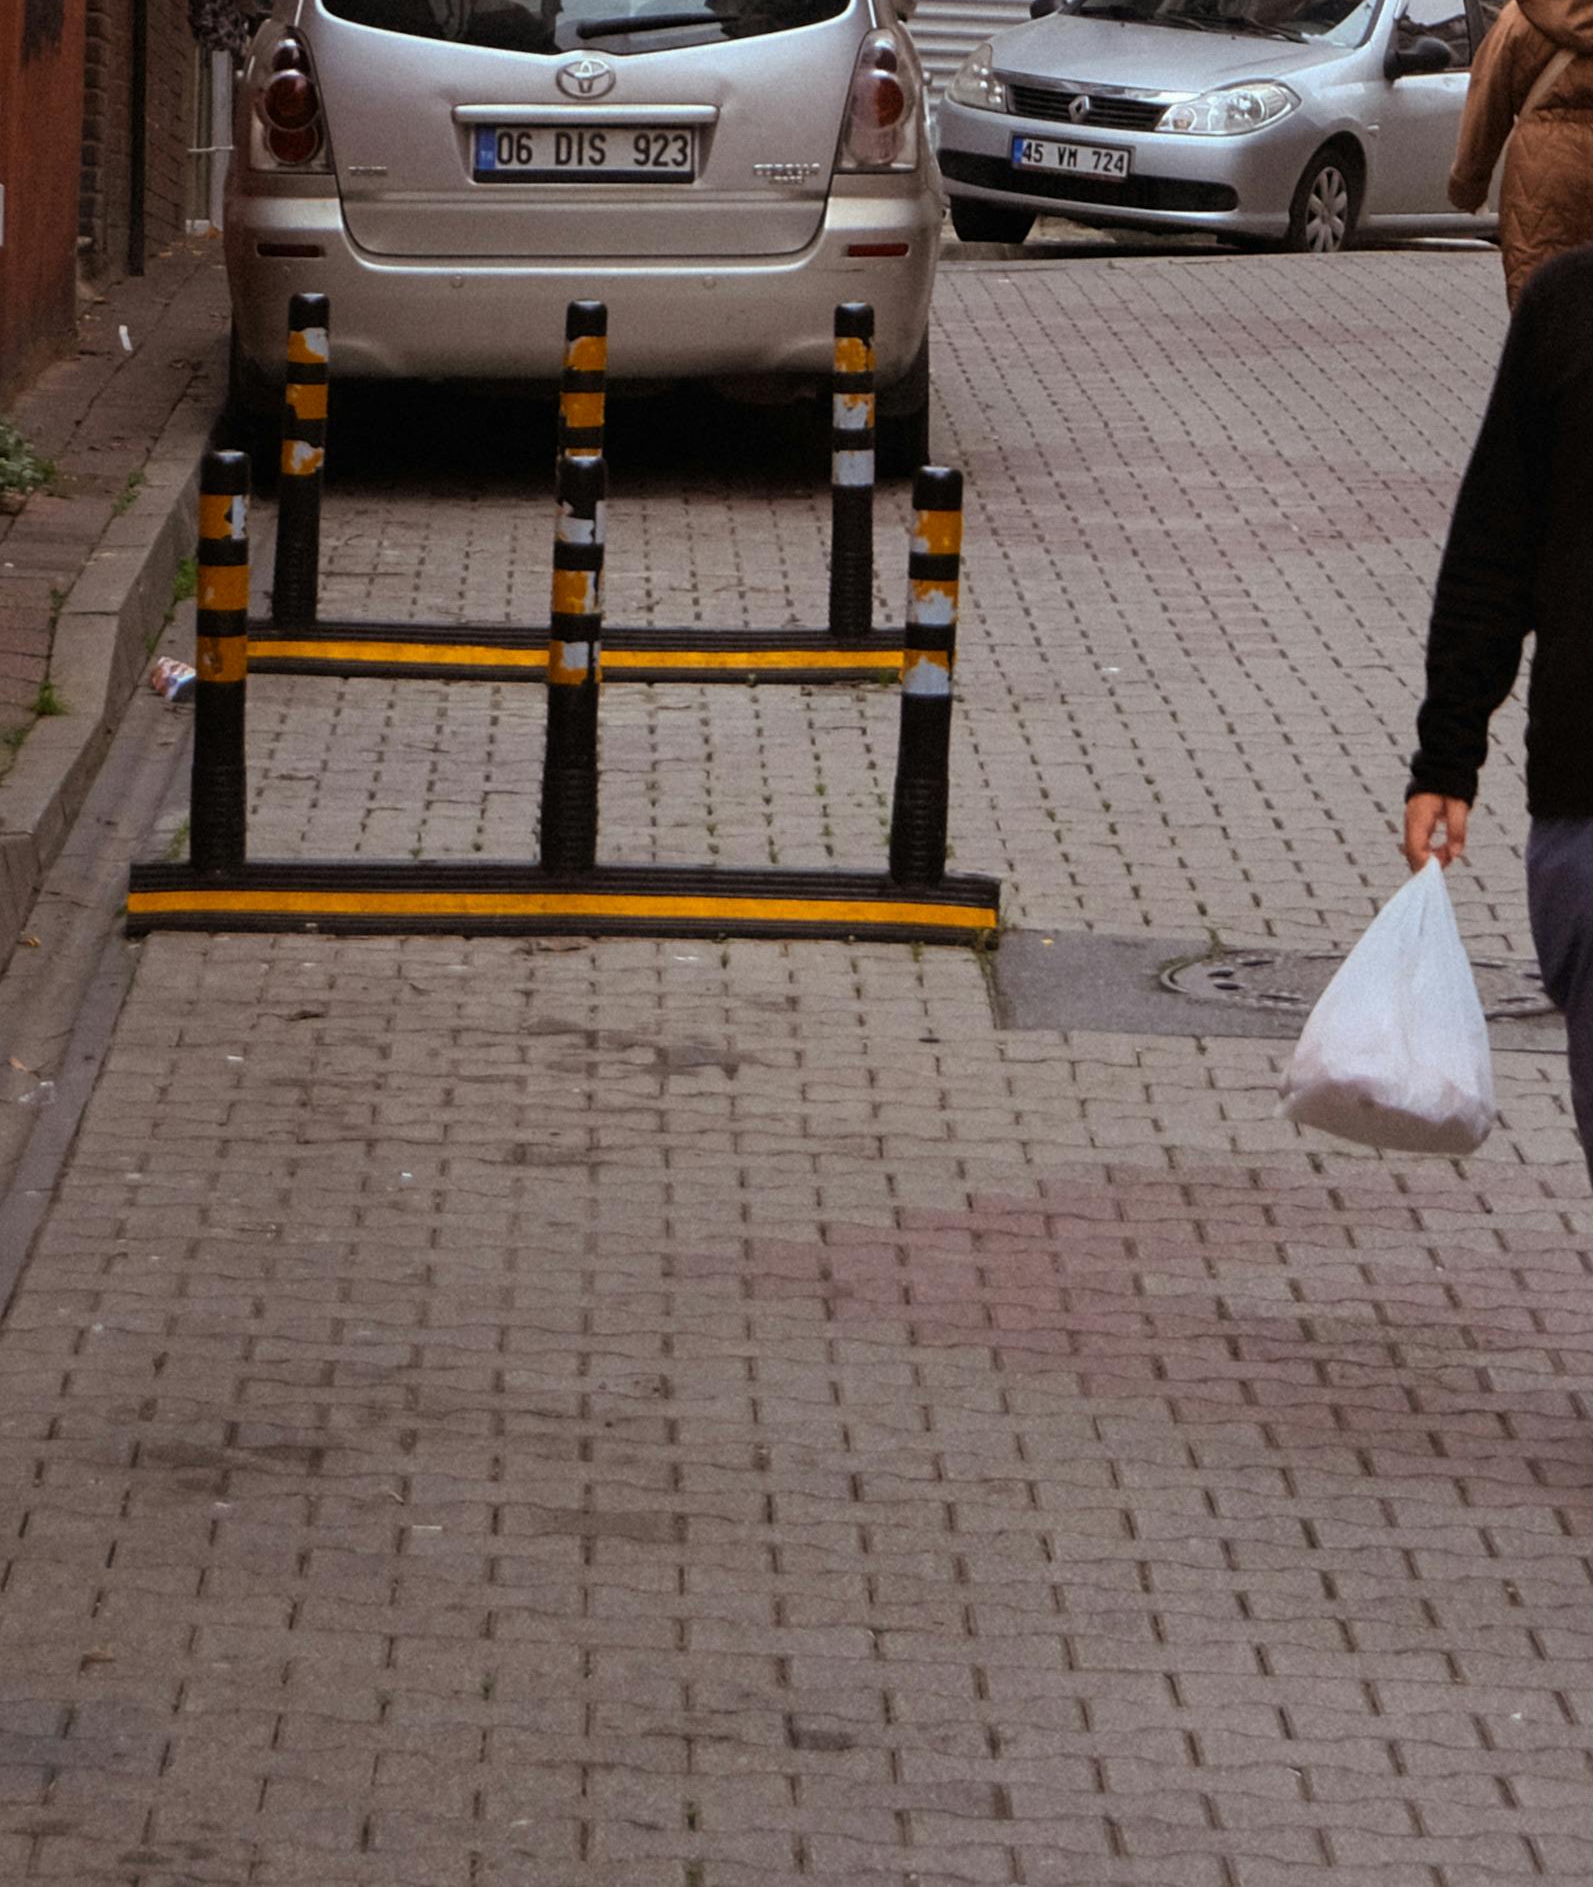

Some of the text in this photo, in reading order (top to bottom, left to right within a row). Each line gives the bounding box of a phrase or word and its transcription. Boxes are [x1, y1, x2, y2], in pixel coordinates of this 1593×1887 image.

[497, 132, 689, 167] 06 DIS 923
[1023, 141, 1125, 173] 45 VM 724
